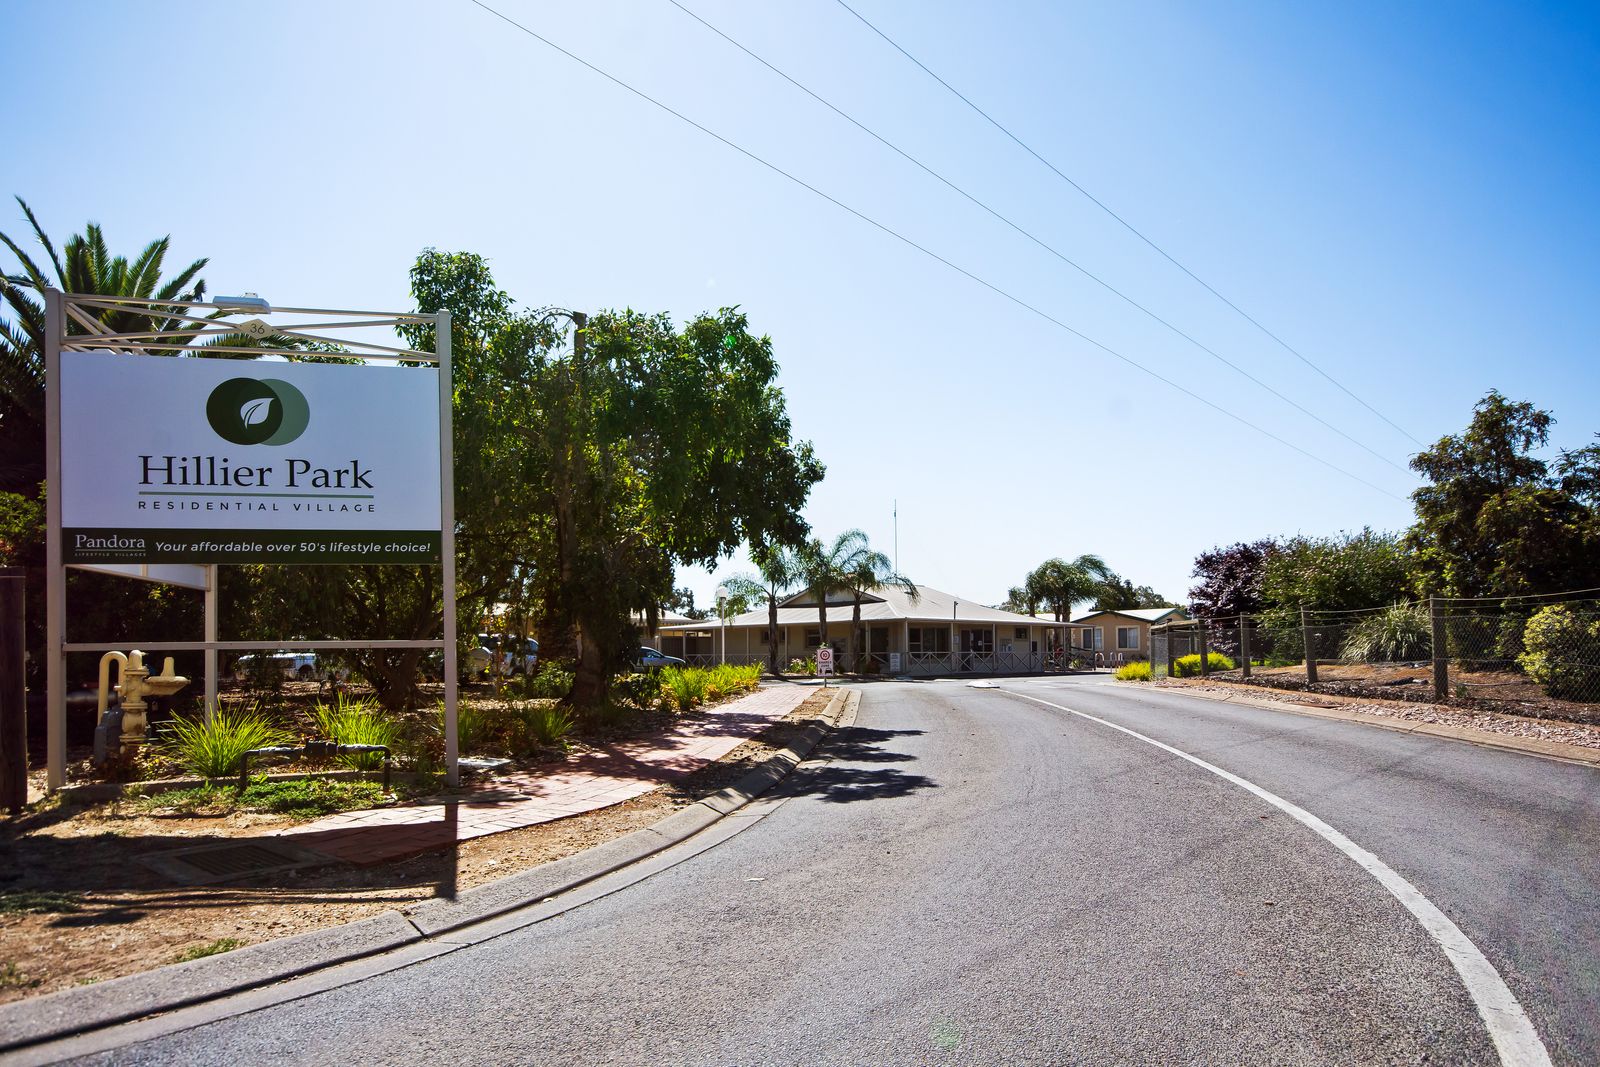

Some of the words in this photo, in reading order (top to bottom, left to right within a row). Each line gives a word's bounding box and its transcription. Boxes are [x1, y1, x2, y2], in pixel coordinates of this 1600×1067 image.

[250, 323, 264, 334] 36
[138, 455, 272, 487] Hillier
[285, 458, 374, 489] Park
[138, 501, 279, 511] RESIDENTIAL
[293, 503, 375, 513] VILLAGE
[75, 534, 146, 548] Pandora
[155, 541, 187, 552] Your
[191, 542, 263, 552] affordable
[266, 543, 296, 552] over
[300, 542, 326, 552] 50's
[329, 542, 381, 554] lifestyle
[384, 543, 431, 552] choice!
